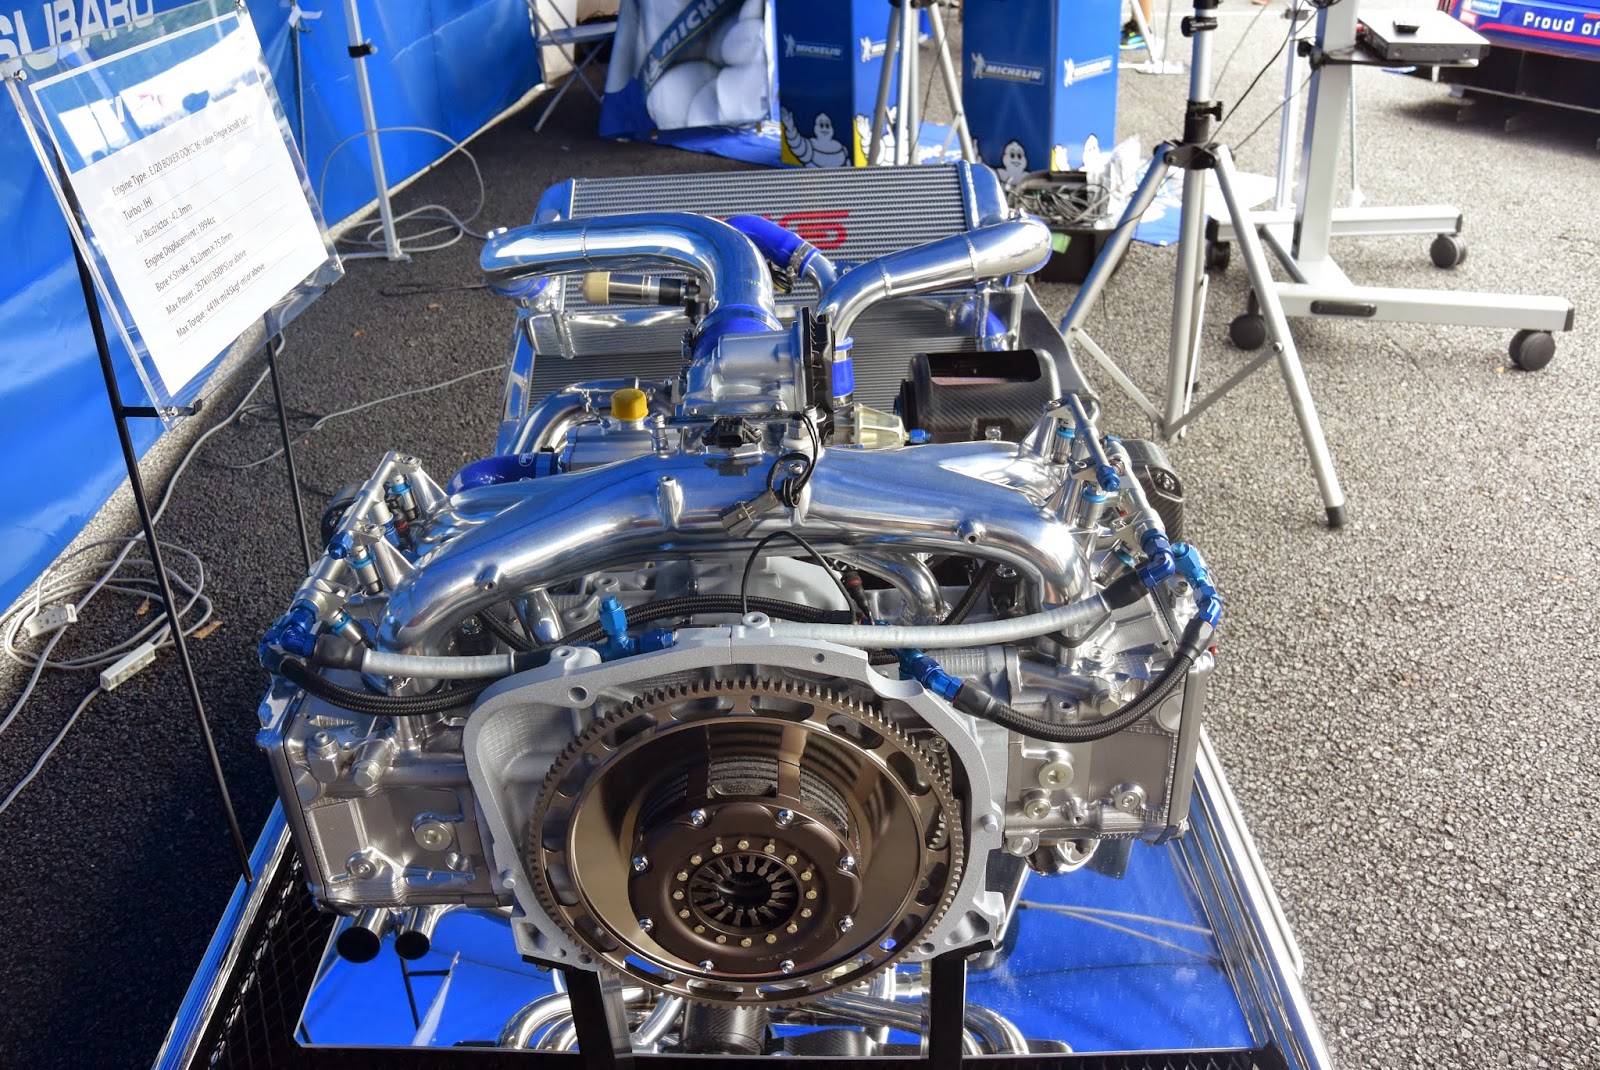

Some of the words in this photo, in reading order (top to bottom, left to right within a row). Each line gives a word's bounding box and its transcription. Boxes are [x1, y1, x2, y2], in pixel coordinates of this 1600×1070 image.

[662, 0, 724, 56] MICH
[1523, 11, 1575, 33] Proud
[1581, 22, 1600, 36] of
[796, 44, 841, 57] MICHELIN
[985, 64, 1042, 80] MICHELIN
[112, 180, 133, 196] Engine
[131, 173, 147, 186] Type
[148, 162, 162, 175] EJ20
[161, 152, 180, 168] BOXER
[122, 206, 141, 220] Turbo
[135, 234, 143, 245] Air
[143, 218, 169, 239] Restrictor
[144, 252, 164, 268] Engine
[162, 229, 197, 256] Displacement
[198, 217, 216, 231] 1994cc
[155, 279, 169, 292] Bore
[172, 264, 189, 280] Stroke
[166, 302, 179, 315] Max
[177, 290, 194, 306] Power
[232, 250, 247, 263] above
[176, 325, 189, 338] Max
[187, 311, 205, 328] Torque
[251, 263, 265, 277] above
